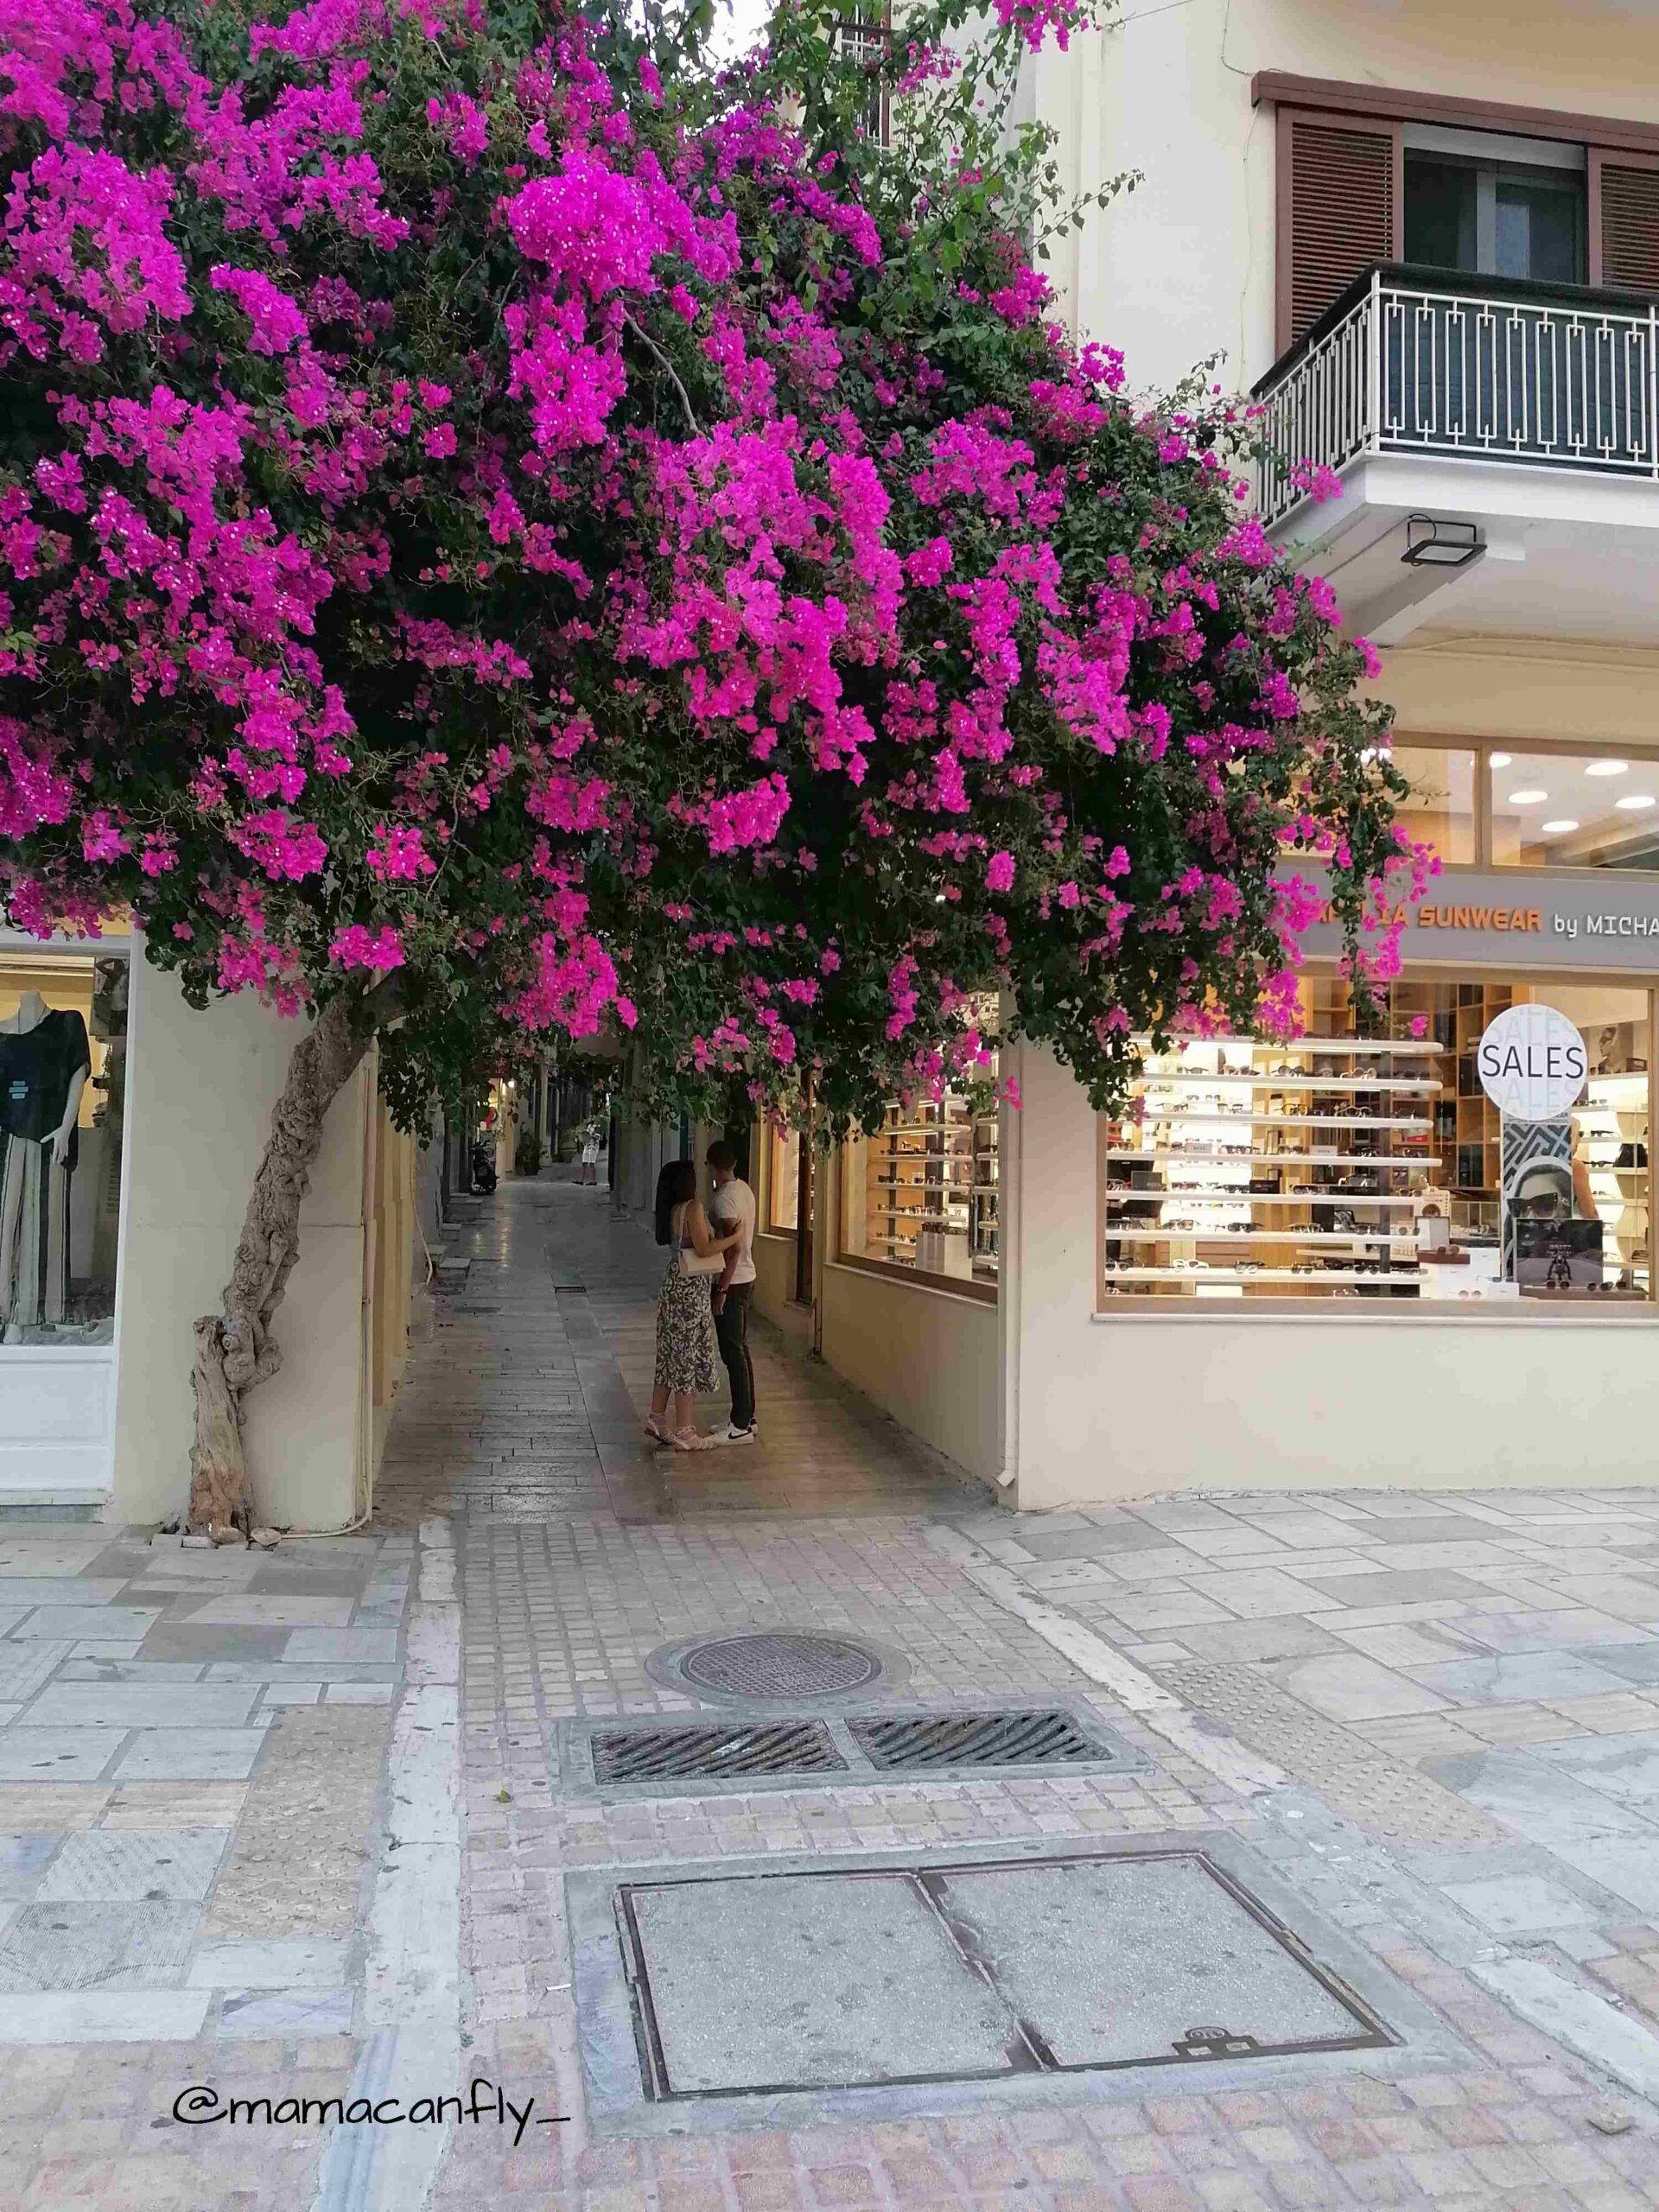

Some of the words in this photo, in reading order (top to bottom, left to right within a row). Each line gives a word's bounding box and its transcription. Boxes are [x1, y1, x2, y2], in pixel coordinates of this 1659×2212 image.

[1418, 905, 1542, 931] SUNWEAR
[1554, 913, 1578, 938] by
[1482, 1045, 1584, 1079] SALES
